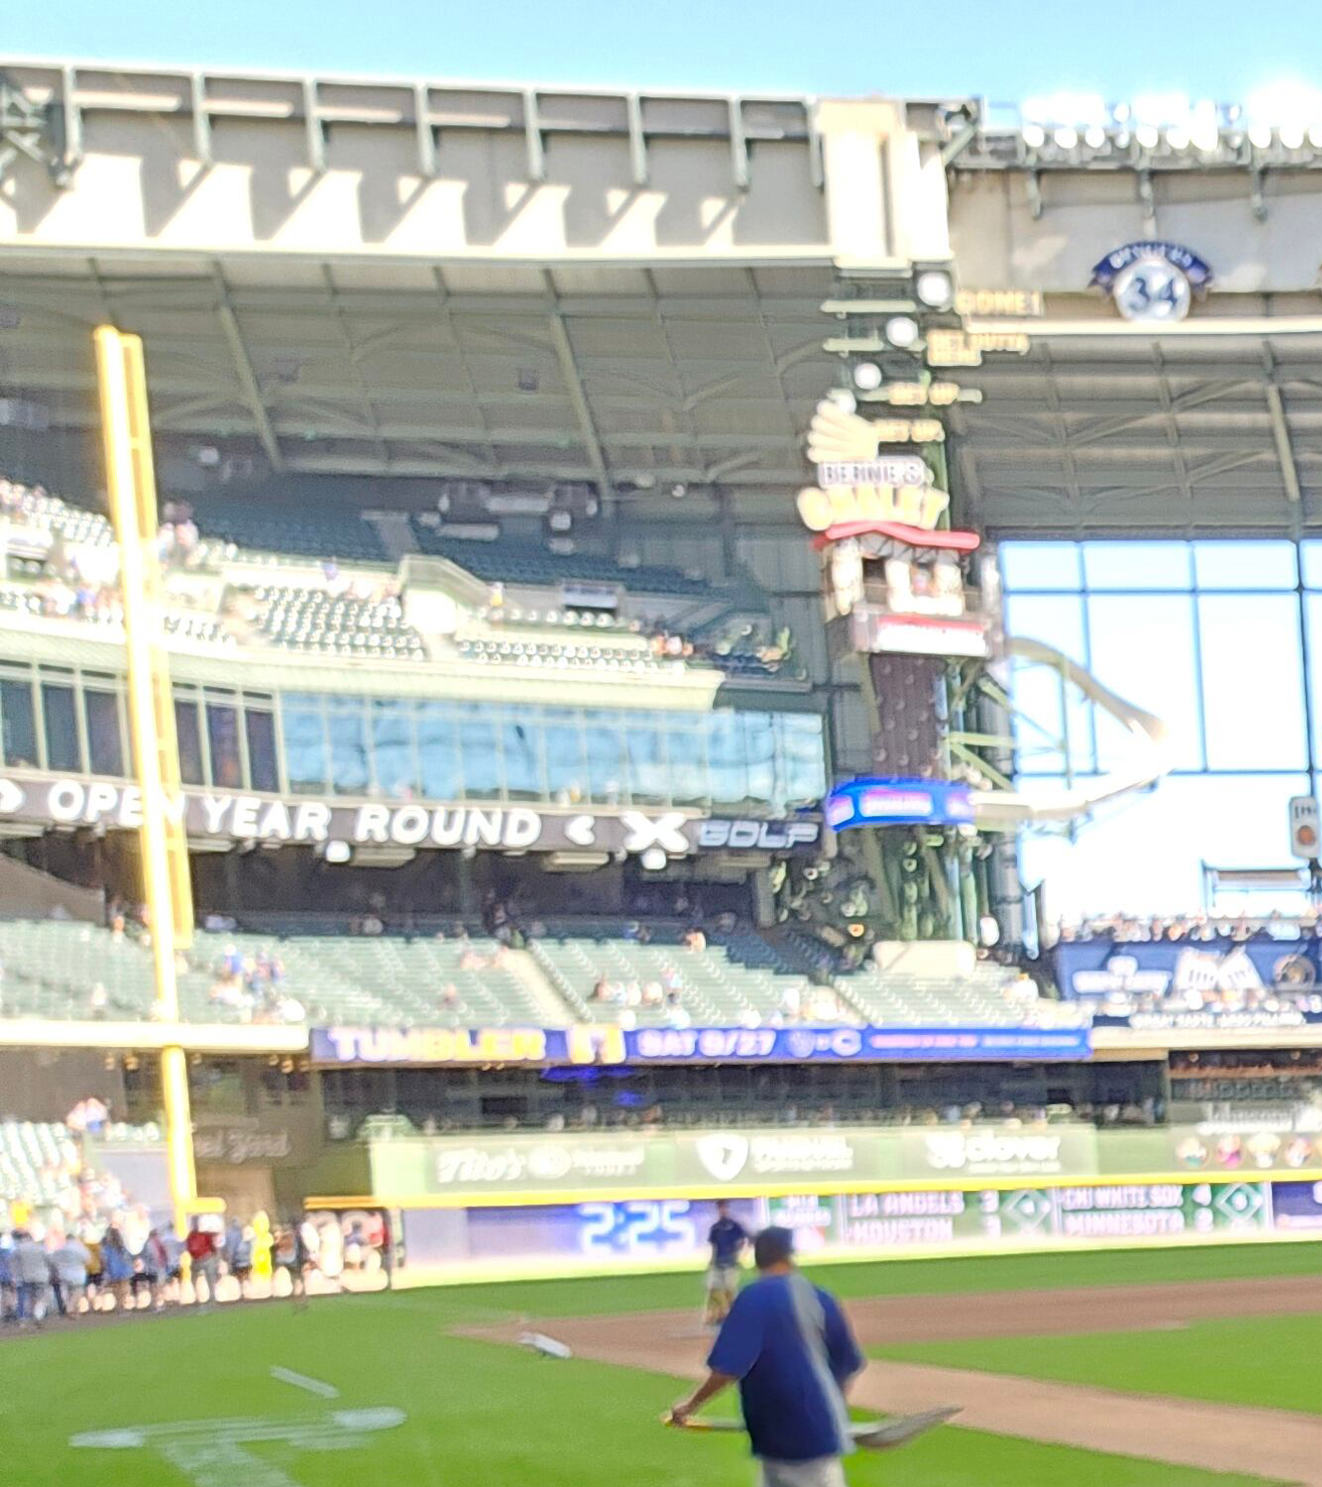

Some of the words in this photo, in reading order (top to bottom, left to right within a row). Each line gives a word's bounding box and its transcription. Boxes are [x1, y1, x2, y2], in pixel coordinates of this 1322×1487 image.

[1128, 276, 1178, 312] 34
[201, 794, 331, 841] YEAR
[355, 802, 541, 849] ROUND
[699, 819, 818, 849] GOLF
[328, 1027, 546, 1062] TUMBLER
[637, 1031, 697, 1057] SAT
[437, 1147, 526, 1183] Tito's
[850, 1193, 878, 1218] LA
[883, 1190, 965, 1216] ANGELS
[577, 1200, 696, 1258] 2:25
[853, 1217, 954, 1244] HOUSTON
[1063, 1209, 1185, 1237] MINNESOTA
